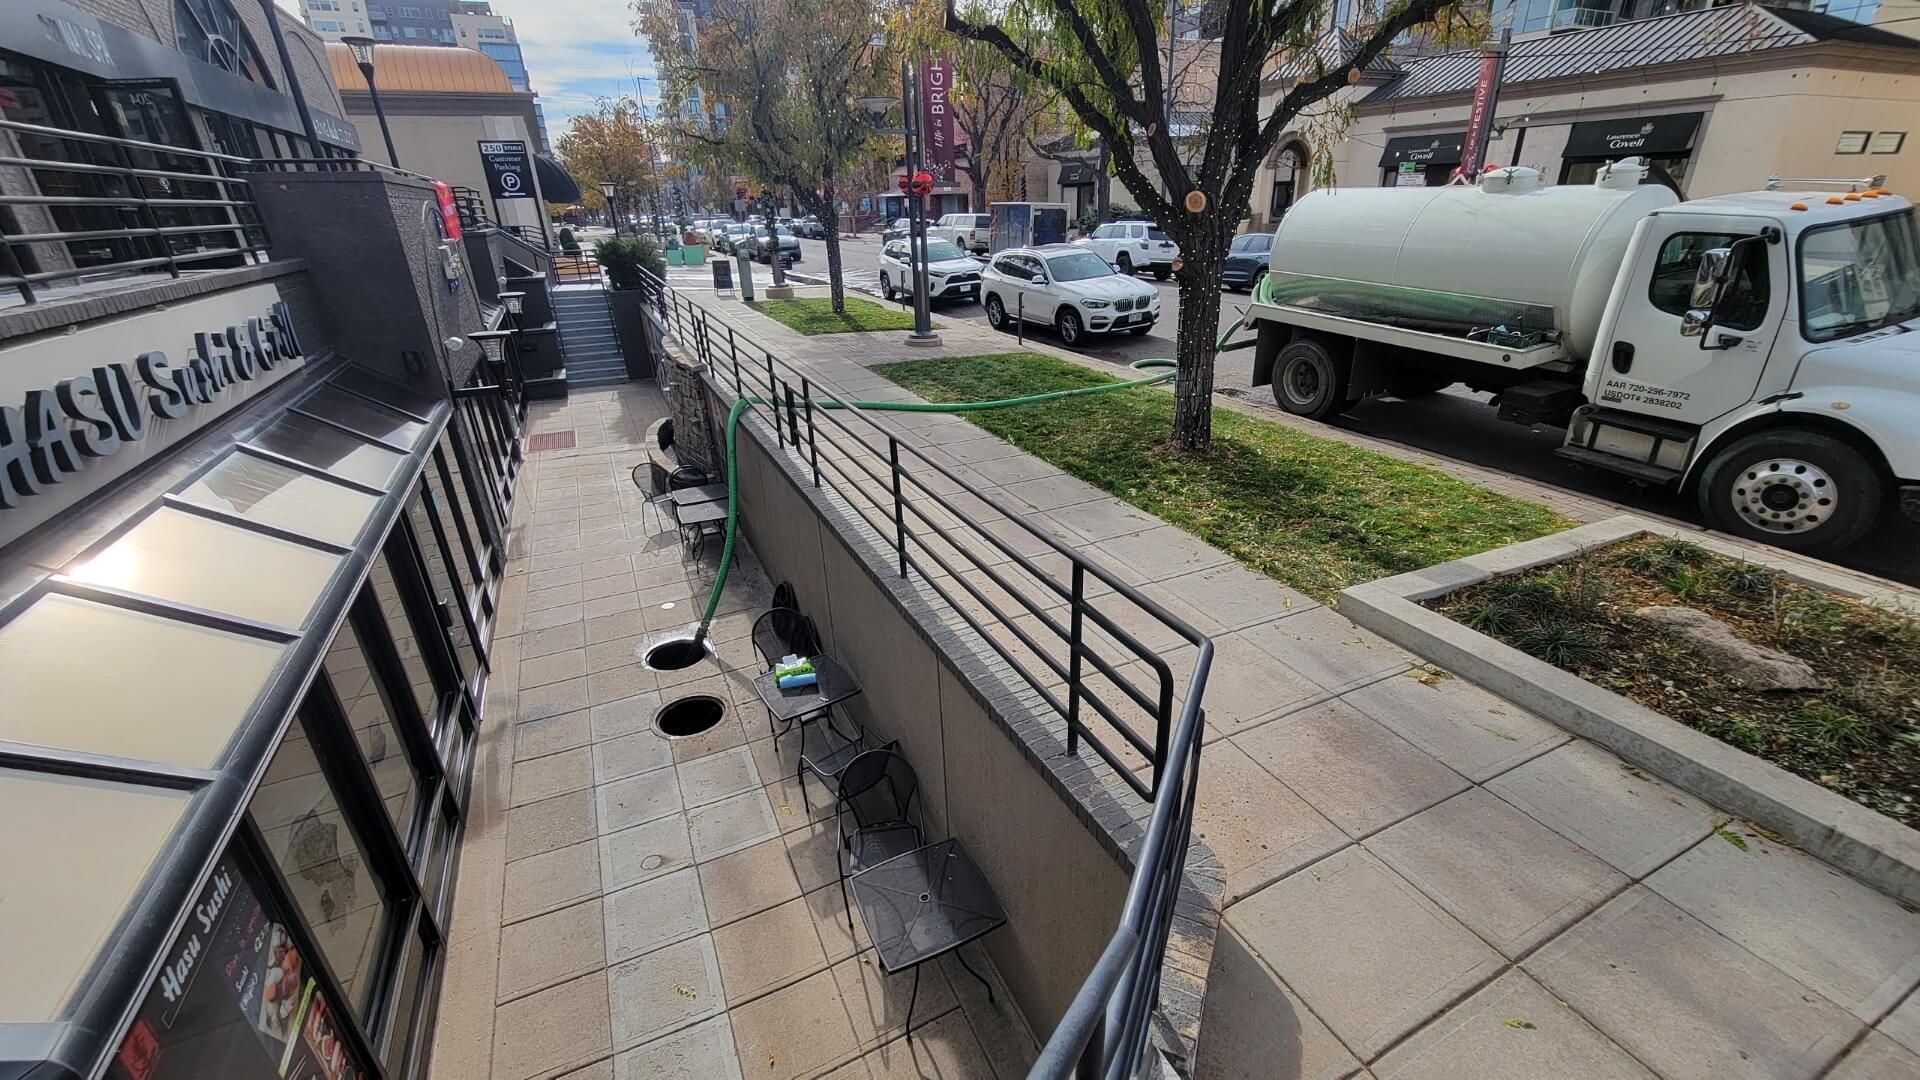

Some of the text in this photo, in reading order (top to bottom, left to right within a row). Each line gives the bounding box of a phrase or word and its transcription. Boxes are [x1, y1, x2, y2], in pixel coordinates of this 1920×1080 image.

[929, 50, 945, 115] BRIGH
[1472, 78, 1489, 129] FESTIVE
[933, 129, 945, 148] Life
[1610, 138, 1646, 149] Covell
[483, 144, 503, 153] 250
[488, 155, 522, 163] Customer
[494, 163, 522, 173] Parking
[1605, 390, 1682, 409] USDOT# 2838202
[1607, 381, 1691, 400] AAR 720-296-7972
[0, 362, 145, 509] HASU
[136, 331, 238, 420] Sushi
[160, 865, 233, 1003] Hasu Sushi
